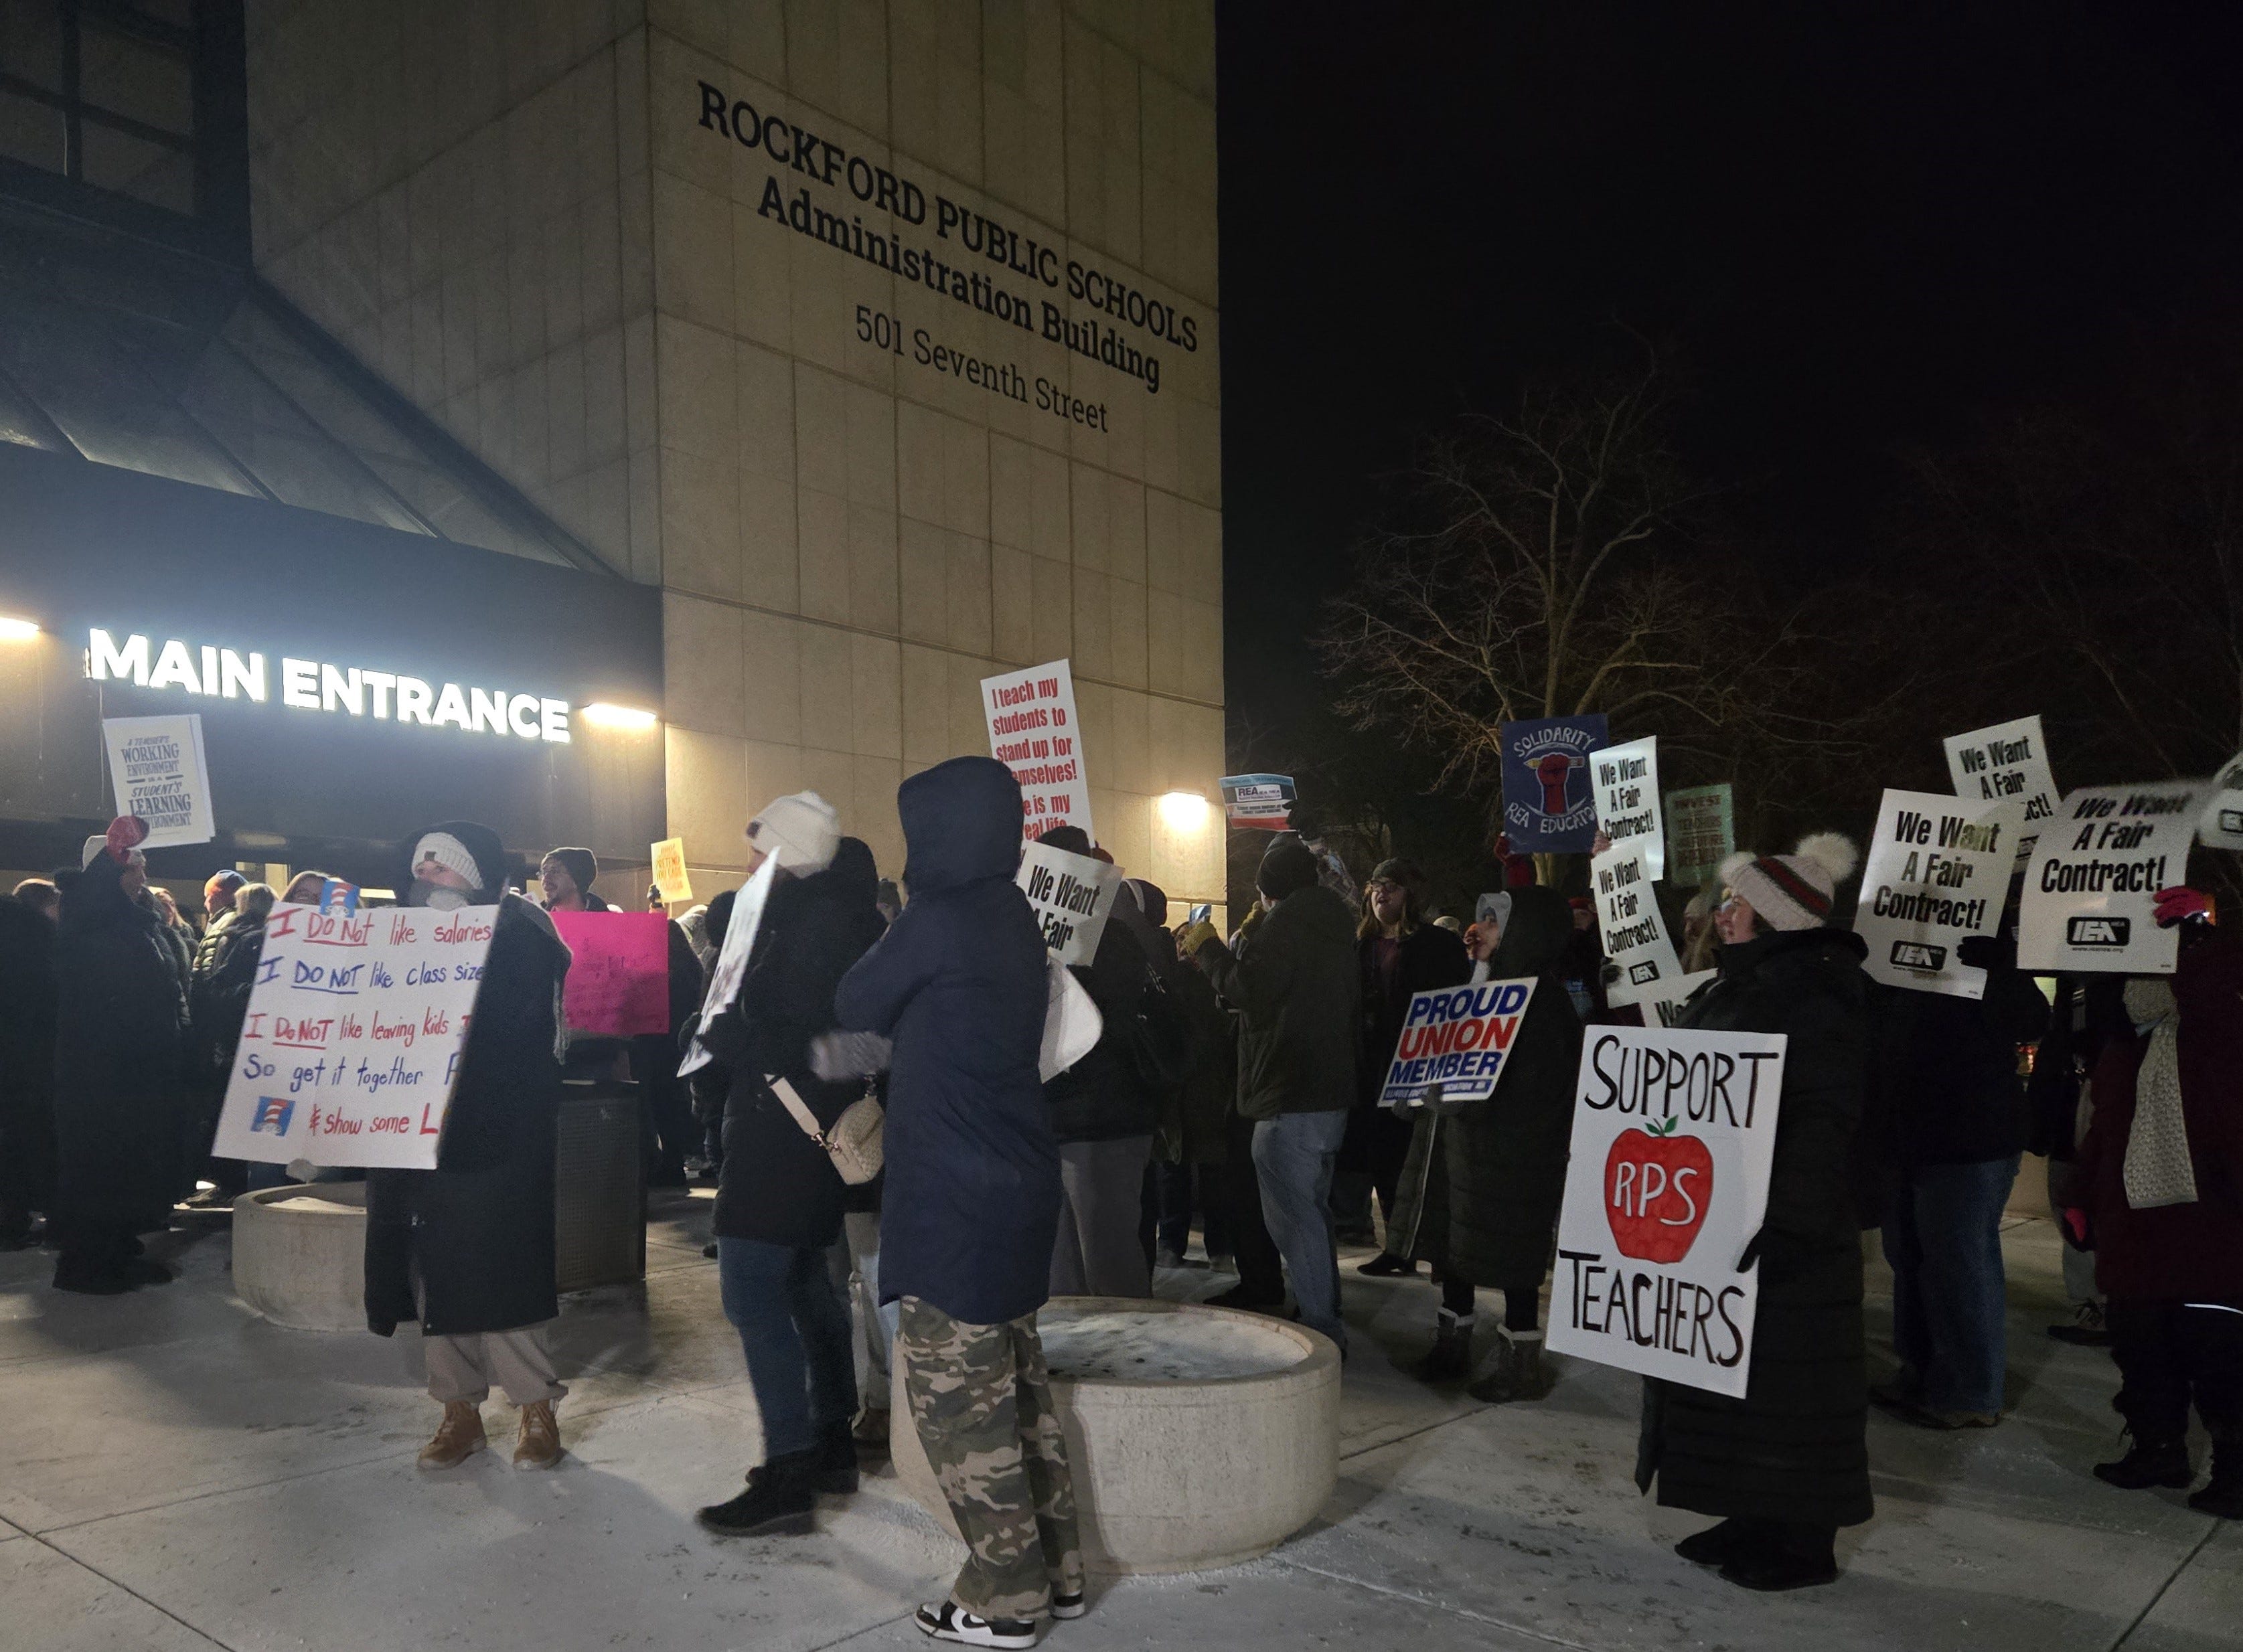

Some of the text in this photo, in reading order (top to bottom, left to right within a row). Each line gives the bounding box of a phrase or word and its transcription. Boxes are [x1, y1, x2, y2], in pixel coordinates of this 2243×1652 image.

[698, 80, 1197, 352] ROCKFORD PUBLIC SCHOOLS
[758, 175, 1160, 394] Administration Building
[856, 305, 1108, 434] 501 Seventh Street
[86, 629, 570, 744] MAIN ENTRANCE
[992, 677, 1059, 710] I teach my
[993, 707, 1067, 736] students to
[121, 743, 179, 763] WORKING
[996, 736, 1073, 762] stand up for
[1513, 726, 1597, 758] SOLIDARITY
[1959, 736, 2032, 773] We Want
[127, 760, 179, 777] ENVIRONMENT
[1012, 759, 1077, 787] emselves!
[1600, 756, 1648, 787] We Want
[1980, 770, 2025, 800] A Fair
[128, 794, 191, 815] LEARNING
[131, 781, 182, 798] STUDENT'S
[1032, 795, 1045, 814] is
[1051, 794, 1070, 814] my
[1238, 787, 1258, 797] REA
[1611, 784, 1640, 813] A Fair
[2072, 798, 2116, 819] We
[2120, 792, 2193, 817] Want
[1024, 819, 1043, 840] eal
[1504, 801, 1598, 834] REA EDUCATO
[1605, 809, 1654, 841] Contract!
[1896, 811, 1932, 845] We
[1938, 815, 2001, 853] Want
[2072, 821, 2154, 851] A Fair
[1599, 857, 1640, 894] We Want
[1902, 851, 1974, 888] A Fair
[2041, 855, 2167, 893] Contract!
[1028, 865, 1100, 917] We Want
[1610, 891, 1638, 922] A Fair
[1873, 884, 1987, 929] Contract!
[268, 908, 303, 938] I
[390, 914, 417, 946] like
[434, 913, 492, 944] salaries
[1042, 912, 1074, 951] Fair
[1607, 916, 1659, 954] Contract!
[2072, 920, 2118, 942] IEA
[257, 955, 285, 985] I
[294, 960, 325, 983] DO
[329, 963, 366, 988] NOT
[369, 961, 394, 989] like
[406, 961, 447, 986] class
[1407, 984, 1528, 1026] PROUD
[244, 1013, 267, 1039] I
[339, 1011, 362, 1040] like
[371, 1010, 416, 1047] leaving
[422, 1005, 448, 1037] kids
[1398, 1016, 1519, 1061] UNION
[244, 1054, 276, 1080] So
[290, 1057, 327, 1092] get
[331, 1056, 346, 1085] it
[357, 1056, 423, 1093] together
[1388, 1052, 1502, 1084] MEMBER
[1584, 1034, 1780, 1129] SUPPORT
[323, 1106, 362, 1135] show
[369, 1113, 410, 1133] some
[1614, 1161, 1698, 1226] RPS
[1558, 1249, 1746, 1368] TEACHERS
